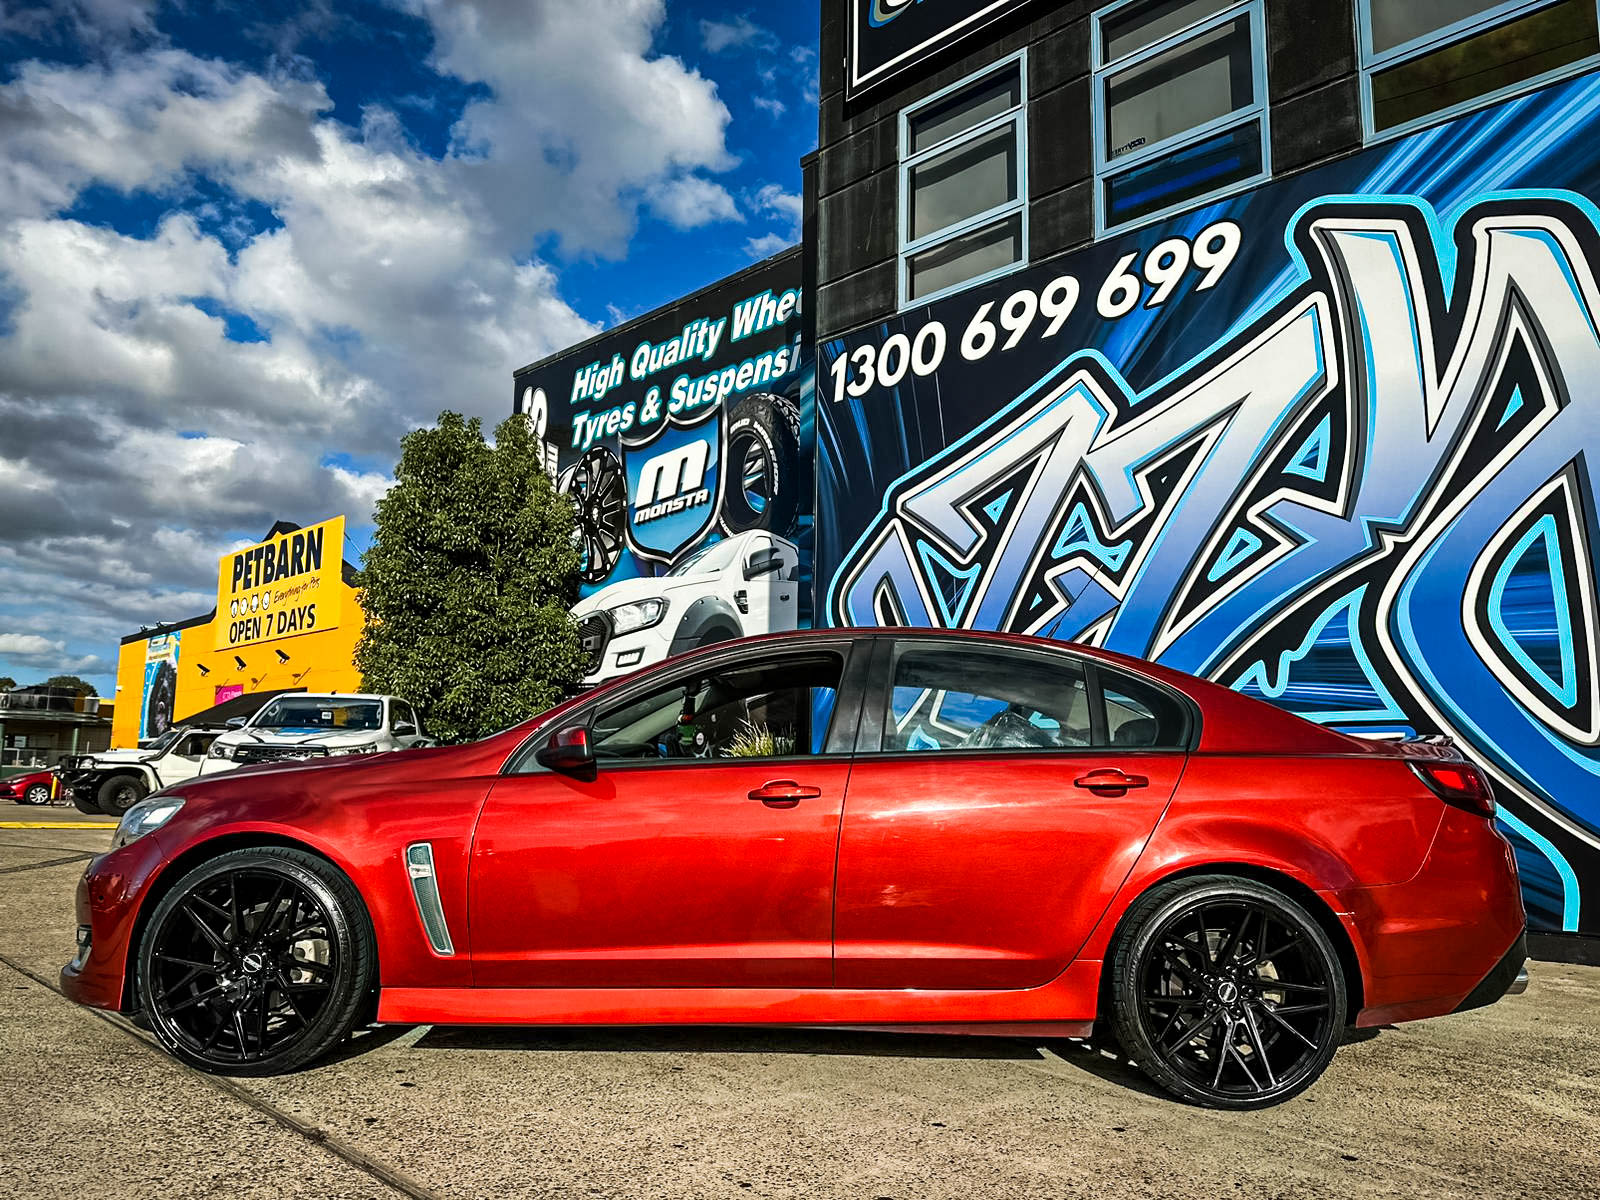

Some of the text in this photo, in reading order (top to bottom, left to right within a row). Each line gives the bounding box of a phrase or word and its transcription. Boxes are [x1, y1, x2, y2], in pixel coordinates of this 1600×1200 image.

[830, 221, 1242, 402] 1300 699 699
[570, 354, 626, 403] High
[630, 318, 727, 380] Quality
[571, 401, 636, 449] Tyres
[639, 385, 661, 425] &
[730, 418, 750, 434] MUD
[232, 527, 324, 593] PETBARN
[230, 604, 315, 643] OPEN 7 DAYS
